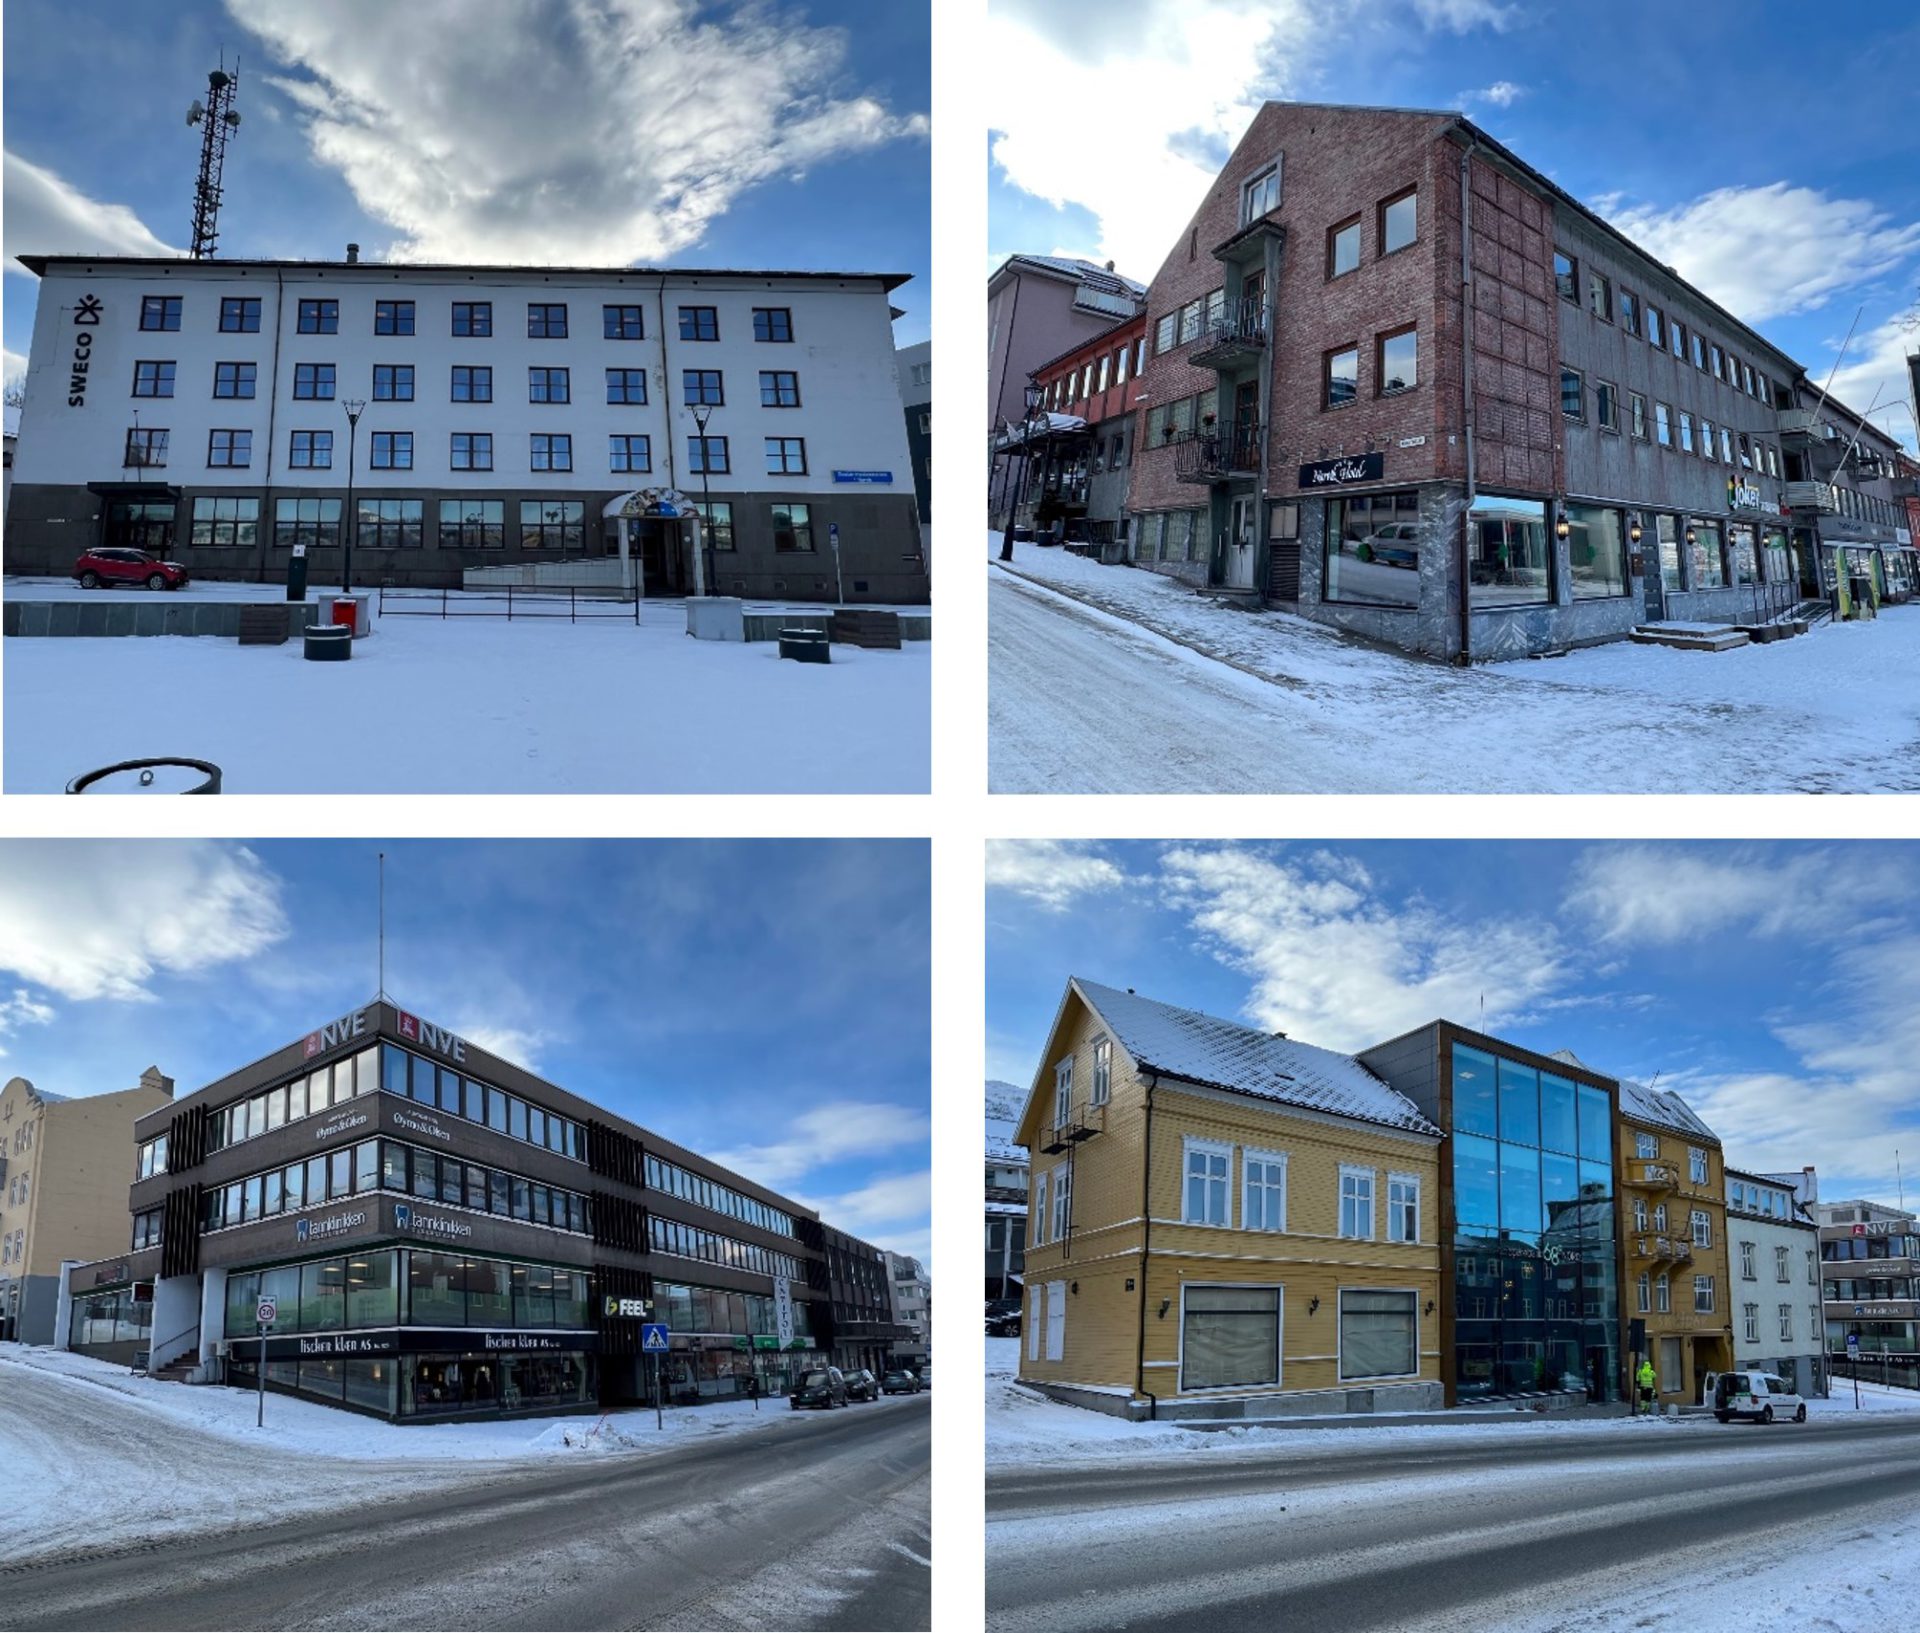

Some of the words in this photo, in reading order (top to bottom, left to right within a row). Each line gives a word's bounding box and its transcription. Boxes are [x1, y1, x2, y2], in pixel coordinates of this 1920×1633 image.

[68, 332, 92, 407] SWECO
[320, 1008, 366, 1052] NVE
[418, 1019, 466, 1062] NVE
[1865, 1222, 1897, 1235] NVE
[619, 1299, 647, 1316] FEEL
[360, 1339, 372, 1350] AS
